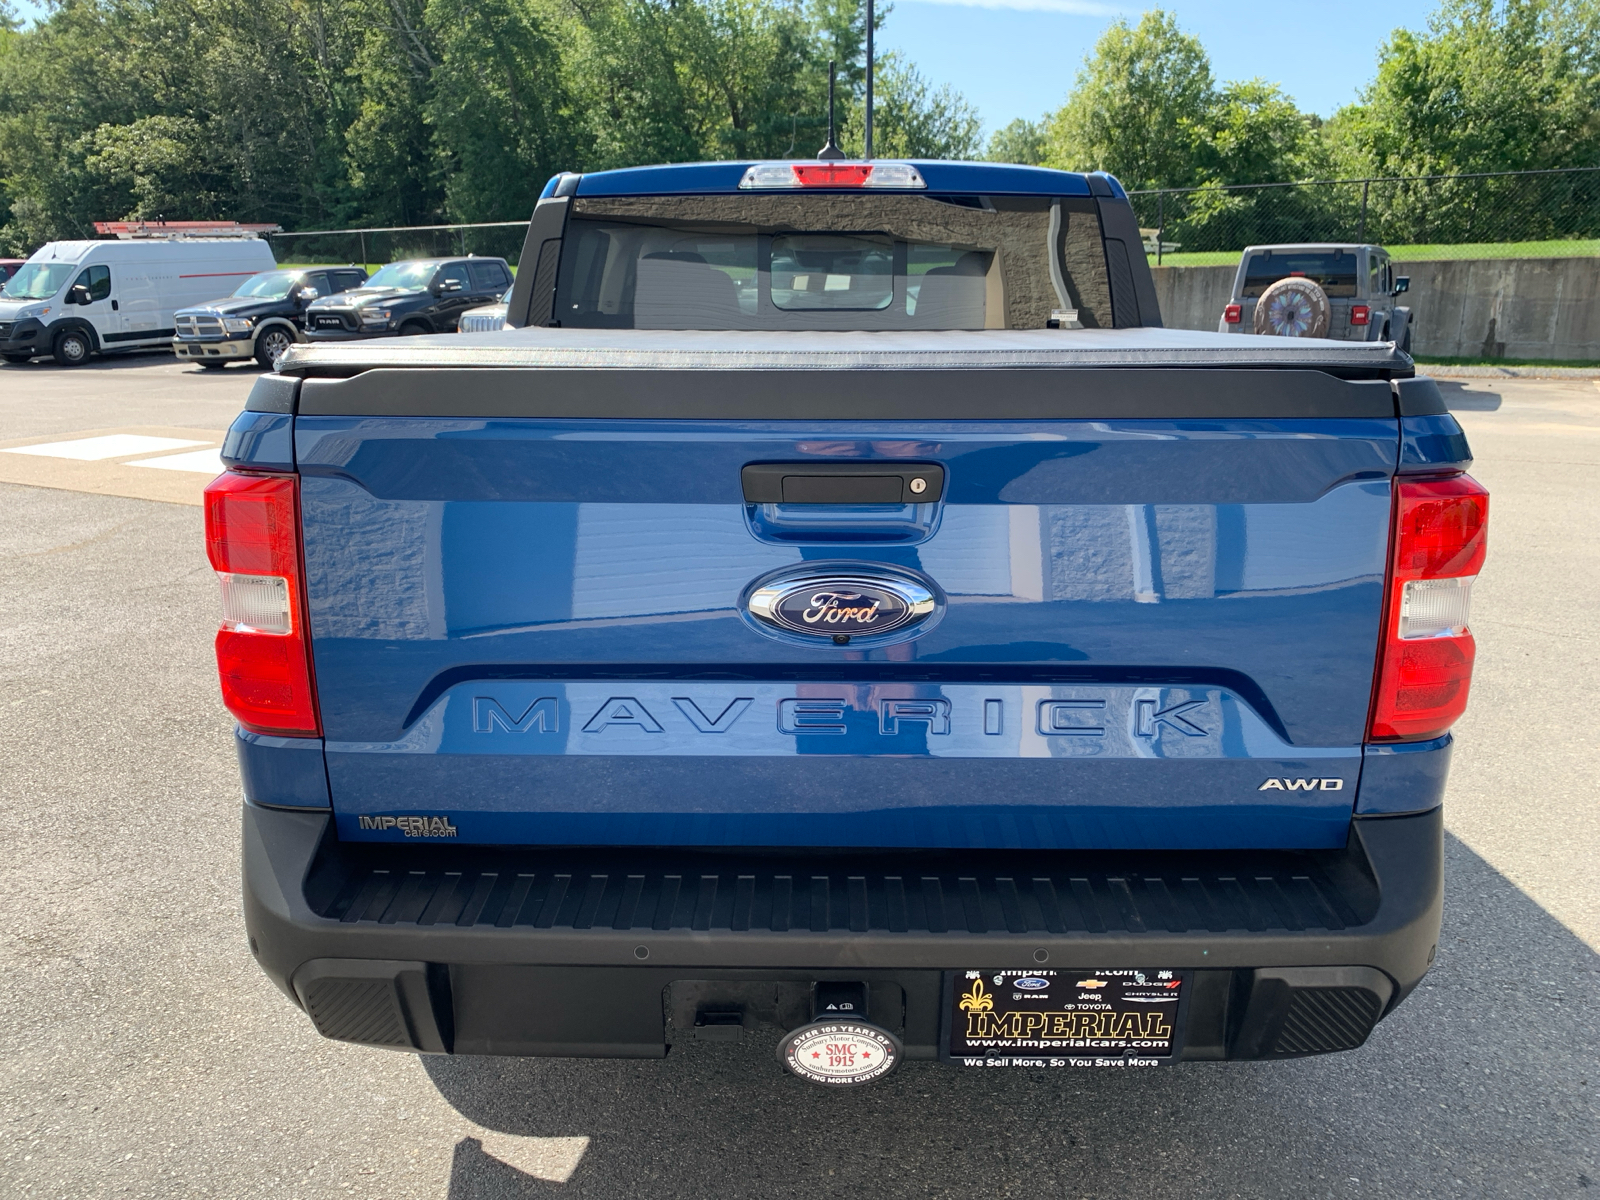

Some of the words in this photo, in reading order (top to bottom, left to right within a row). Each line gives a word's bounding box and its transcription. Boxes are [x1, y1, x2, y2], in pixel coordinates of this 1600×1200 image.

[802, 591, 881, 624] Ford
[472, 696, 1211, 737] MAVERICK
[1257, 778, 1344, 791] AWD
[358, 815, 457, 830] IMPERIAL
[404, 829, 457, 838] cars.com
[1020, 980, 1042, 988] Ford
[1077, 993, 1102, 1001] Jeep
[966, 1011, 1171, 1038] IMPERIAL
[793, 1029, 819, 1046] OVER
[840, 1026, 875, 1037] YEARS
[877, 1035, 890, 1045] OF
[825, 1043, 858, 1056] SMC
[851, 1035, 880, 1052] Company
[965, 1039, 1169, 1049] www.imperialcars.com
[828, 1055, 855, 1067] 1915
[964, 1059, 983, 1067] We
[986, 1059, 1009, 1067] Sell
[1013, 1059, 1046, 1068] More,
[1050, 1059, 1065, 1067] So
[1069, 1059, 1092, 1067] You
[1095, 1059, 1125, 1067] Save
[1128, 1059, 1159, 1067] More
[787, 1056, 826, 1082] SATISFYING
[854, 1055, 895, 1082] CUSTOMERS
